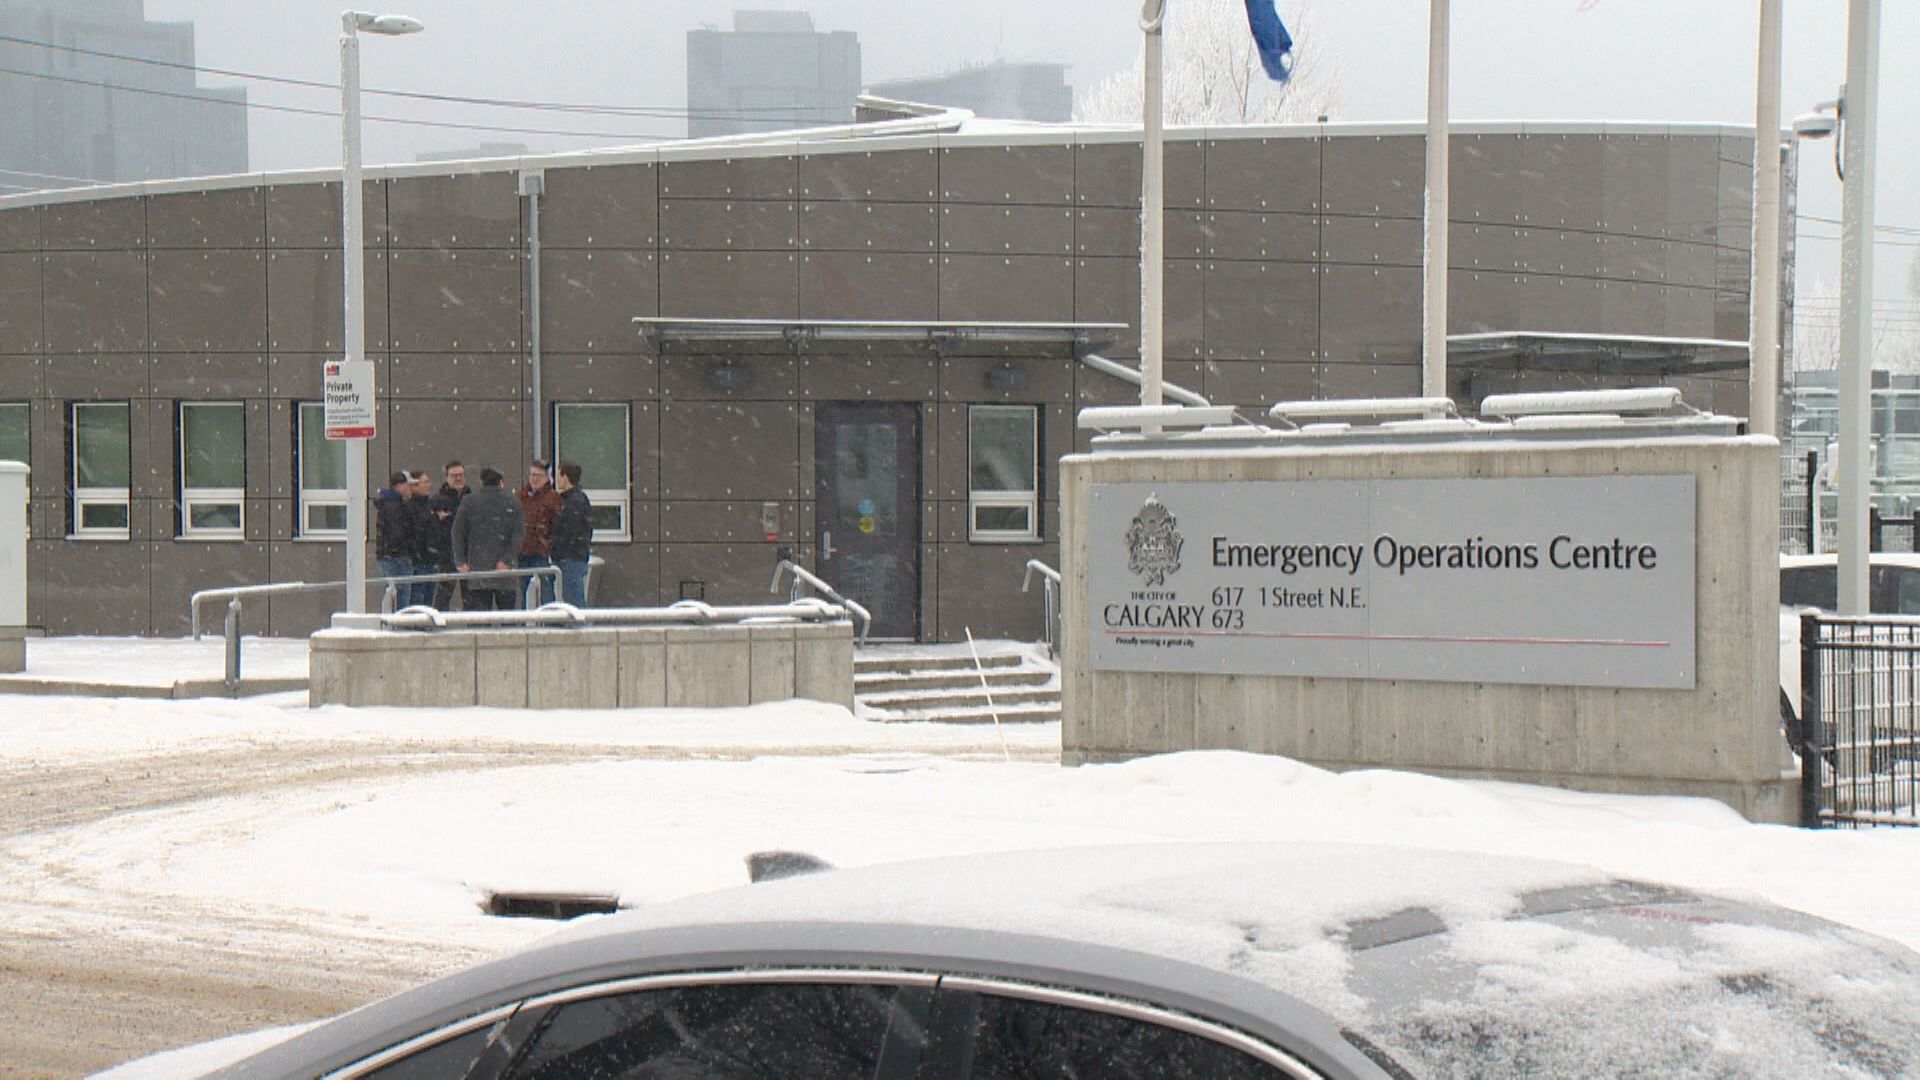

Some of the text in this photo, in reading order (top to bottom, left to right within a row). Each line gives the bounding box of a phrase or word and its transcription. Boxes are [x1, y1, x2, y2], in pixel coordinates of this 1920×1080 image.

[326, 382, 353, 392] Private
[326, 394, 360, 405] Property
[1212, 534, 1657, 576] Emergency Operations Centre
[1130, 591, 1176, 600] THE CITY OF
[1211, 586, 1366, 609] 617 1 Street N.E.
[1103, 603, 1205, 628] CALGARY
[1211, 609, 1244, 630] 673
